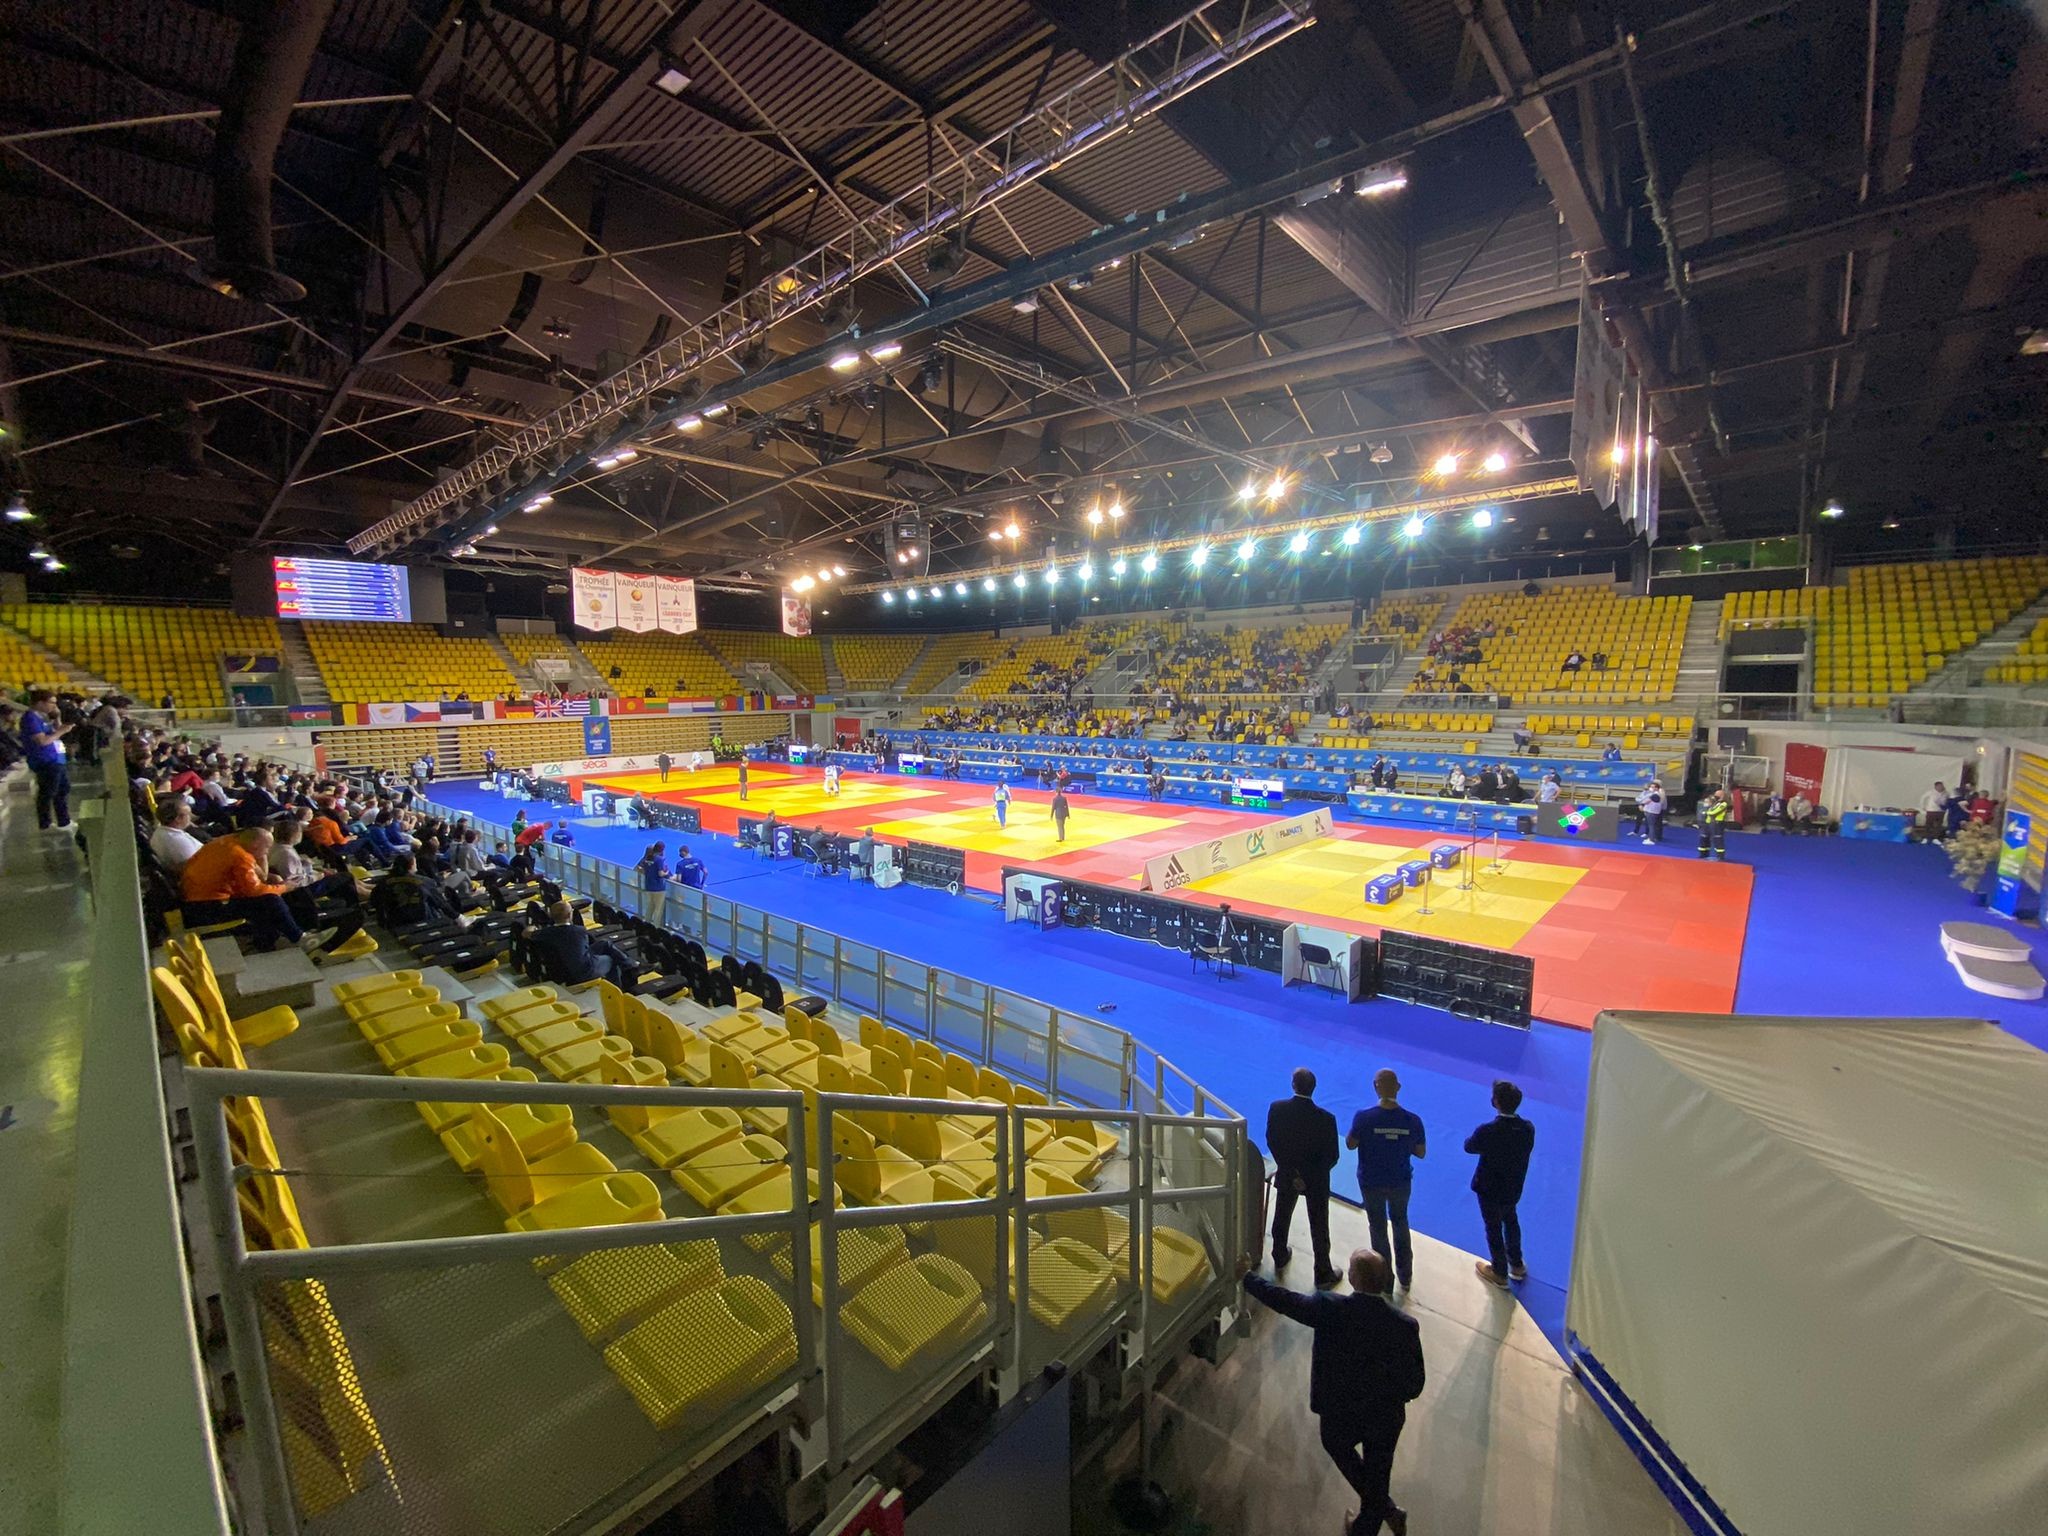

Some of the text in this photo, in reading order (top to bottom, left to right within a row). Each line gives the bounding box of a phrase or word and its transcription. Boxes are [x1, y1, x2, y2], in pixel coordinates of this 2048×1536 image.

[579, 576, 610, 586] TROPHÉE
[617, 580, 656, 589] VAINQUEUR
[657, 583, 693, 593] VAINQUEUR
[582, 759, 608, 770] seca
[1163, 873, 1191, 890] adidas
